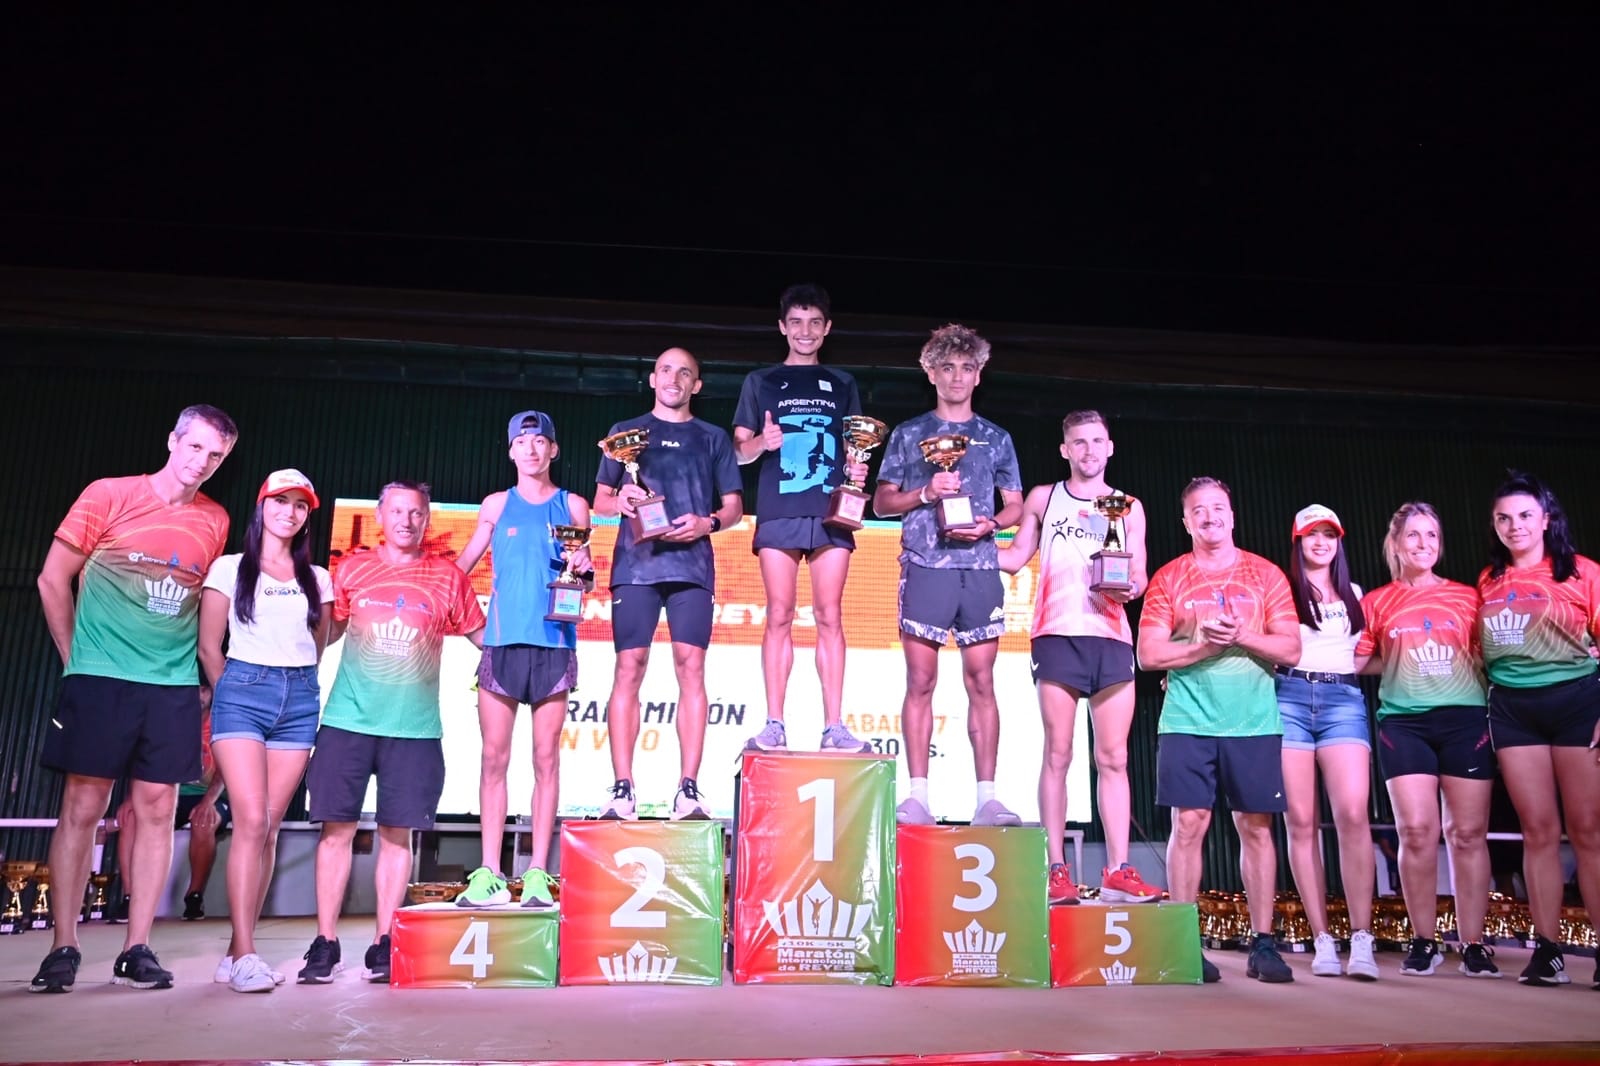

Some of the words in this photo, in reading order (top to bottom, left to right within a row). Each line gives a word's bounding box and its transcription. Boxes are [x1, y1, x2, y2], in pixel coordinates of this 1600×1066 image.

[778, 399, 836, 409] ARGENTINA
[1067, 526, 1105, 542] FCma
[713, 603, 816, 626] EYS
[567, 697, 746, 725] RAMIÓN
[592, 728, 660, 751] VO
[870, 738, 900, 755] 30
[797, 778, 835, 861] 1
[609, 846, 667, 928] 2
[952, 843, 998, 912] 3
[1103, 911, 1132, 955] 5
[449, 921, 494, 978] 4
[777, 948, 855, 959] Maratón
[777, 957, 855, 965] Internacional
[799, 963, 855, 971] REYES
